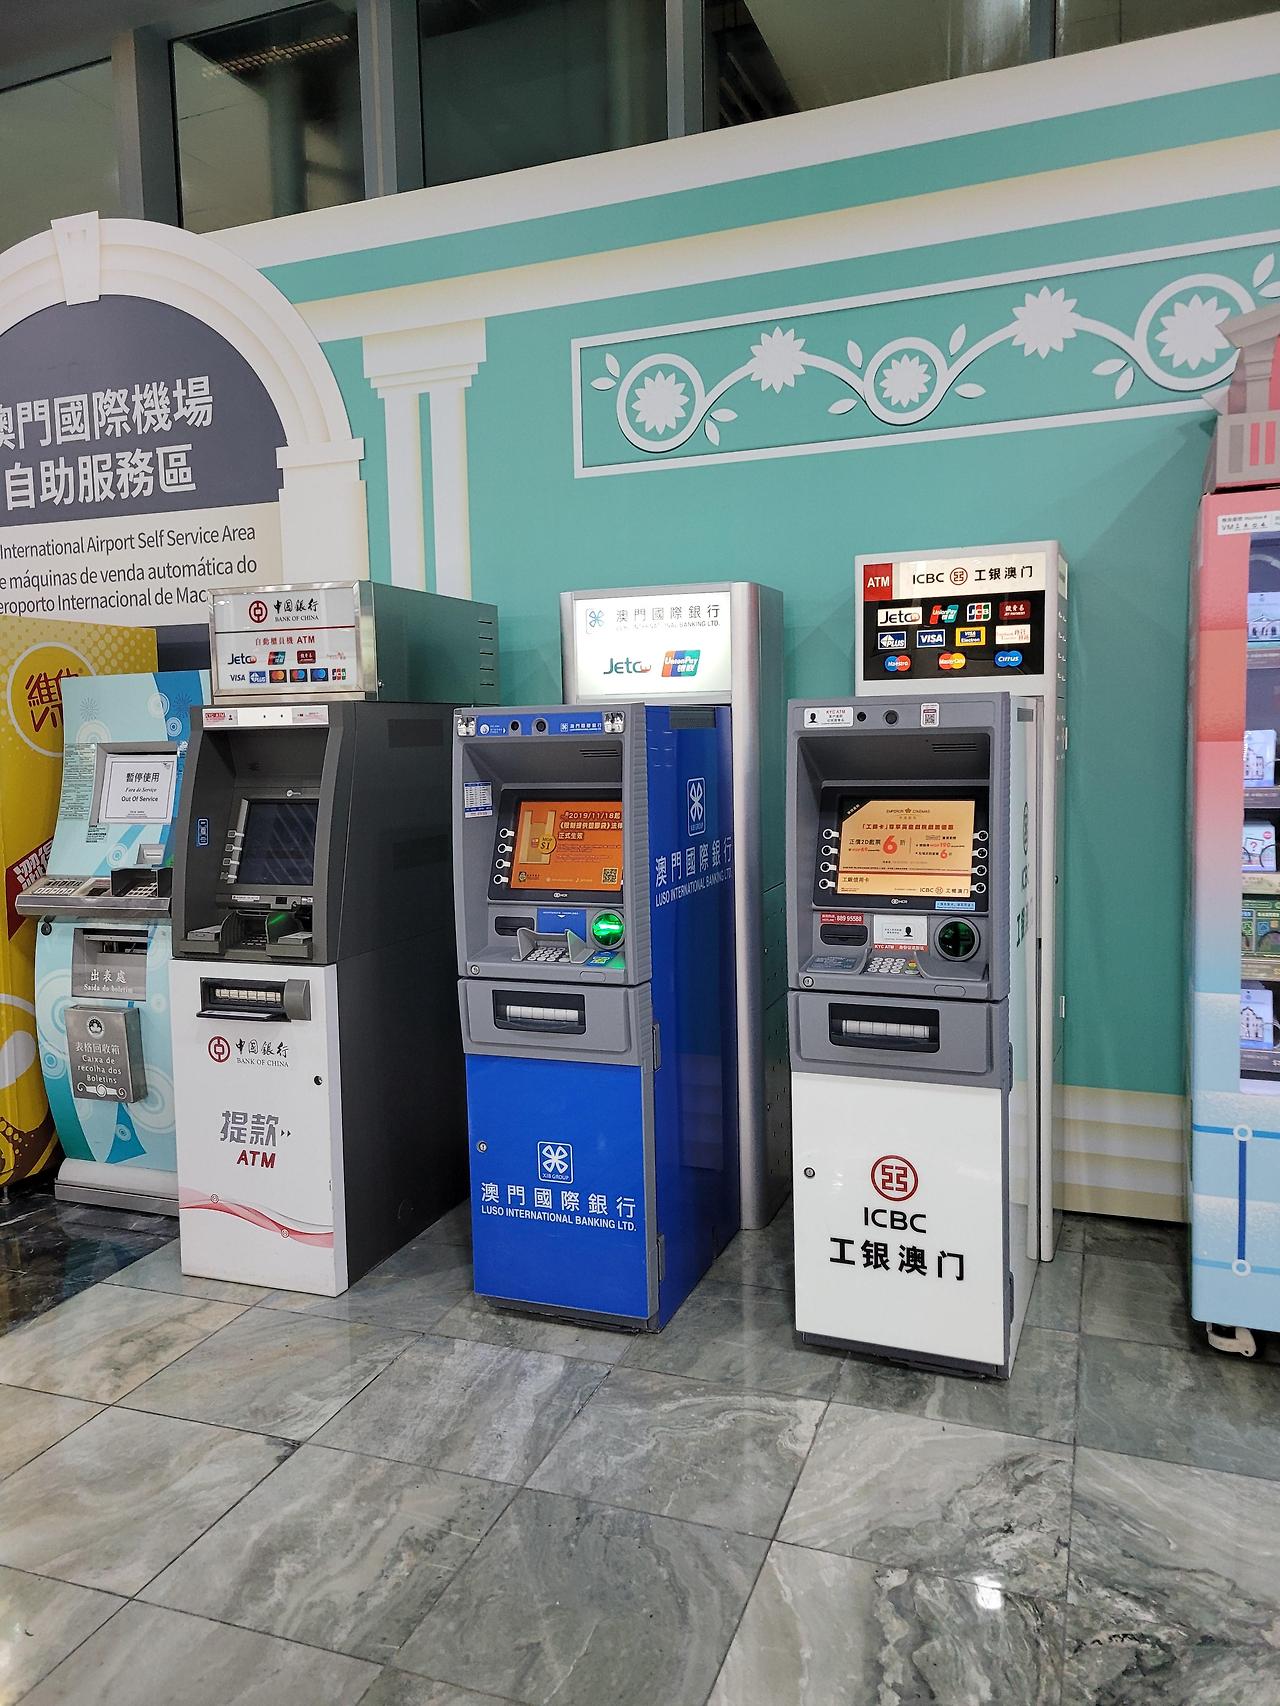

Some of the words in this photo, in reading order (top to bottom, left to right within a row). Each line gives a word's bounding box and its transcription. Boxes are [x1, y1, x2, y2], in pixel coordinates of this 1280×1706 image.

[5, 444, 196, 511] 自助服務區
[0, 536, 84, 559] International
[87, 534, 135, 555] Airport
[138, 529, 165, 548] Self
[167, 526, 219, 546] Service
[222, 525, 255, 542] Area
[10, 569, 77, 591] máquinas
[80, 566, 97, 584] de
[100, 563, 144, 582] venda
[148, 556, 233, 580] automática
[237, 554, 257, 573] do
[867, 576, 890, 588] ATM
[913, 572, 944, 585] ICBC
[974, 565, 1033, 581] 工银澳门
[58, 588, 151, 611] Internacional
[155, 587, 173, 605] de
[176, 587, 208, 604] Mac
[969, 604, 990, 620] JCB
[297, 636, 315, 644] ATM
[887, 639, 905, 648] PLUS
[920, 634, 943, 643] VISA
[664, 656, 699, 665] UnionPay
[25, 668, 79, 705] 維
[126, 772, 159, 782] 暫停使用
[883, 835, 898, 855] 6
[940, 849, 948, 859] 6
[655, 836, 732, 888] 澳門國際銀行
[655, 889, 670, 908] LUSO
[670, 877, 706, 902] INTERNATIONAL
[90, 968, 127, 984] 出表處
[77, 1064, 106, 1074] recolha
[108, 1066, 122, 1075] dos
[82, 1054, 104, 1064] Caixa
[106, 1057, 115, 1065] de
[236, 1057, 255, 1065] BANK
[266, 1060, 289, 1068] CHINA
[86, 1074, 118, 1085] Boletins
[219, 1110, 280, 1147] 提款
[237, 1150, 276, 1169] ATM
[481, 1182, 636, 1219] 澳門國際銀行
[481, 1205, 504, 1216] LUSO
[506, 1207, 573, 1225] INTERNATIONAL
[575, 1215, 615, 1230] BANKING
[617, 1221, 637, 1232] LTD.
[864, 1206, 927, 1234] ICBC
[829, 1237, 964, 1281] 工银澳门
